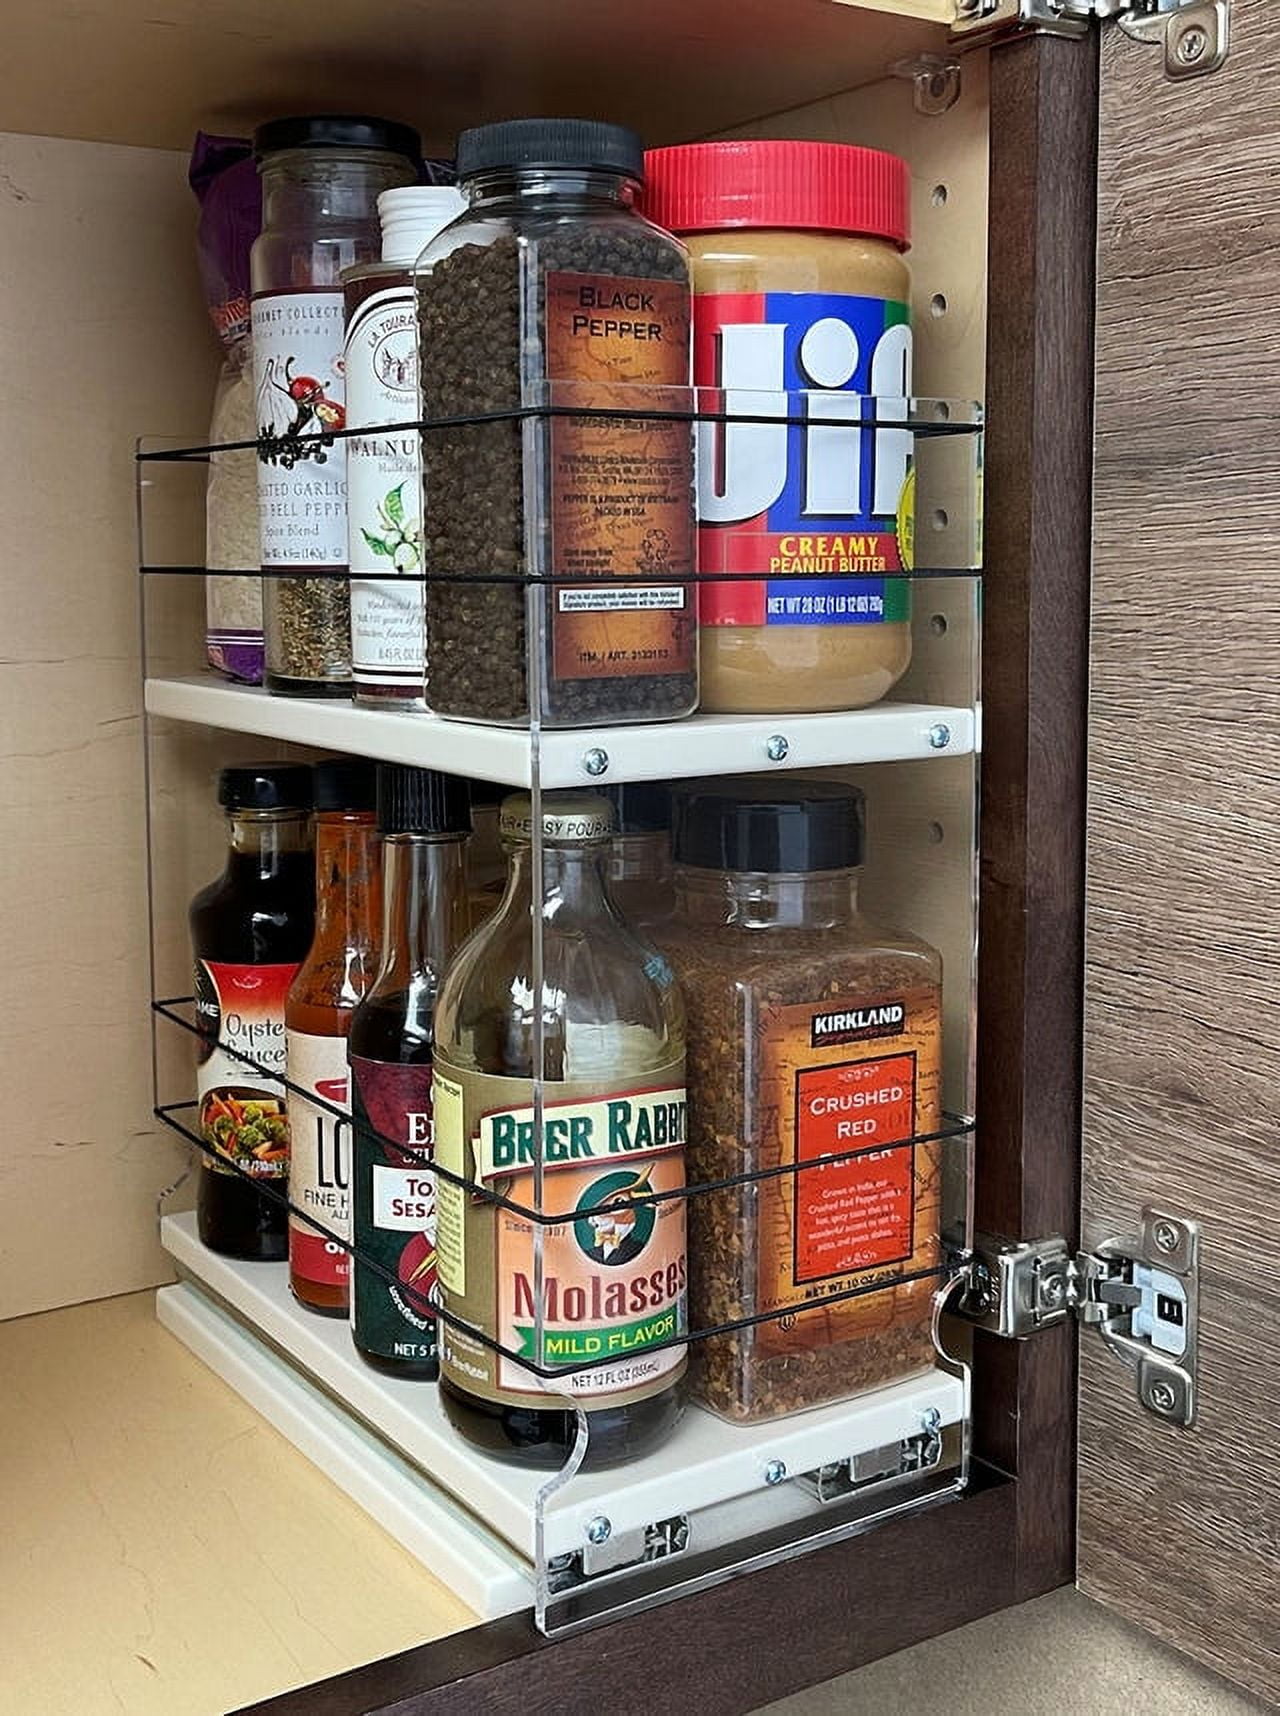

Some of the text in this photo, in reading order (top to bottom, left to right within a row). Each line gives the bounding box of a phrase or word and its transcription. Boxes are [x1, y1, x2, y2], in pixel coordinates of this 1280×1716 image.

[578, 286, 655, 312] BLACK
[572, 315, 663, 342] PEPPER
[696, 317, 914, 523] Jif
[293, 482, 349, 497] GARLIC
[779, 536, 879, 557] CREAMY
[770, 556, 886, 574] PEANUT BUTTER
[767, 597, 784, 614] NET
[814, 1006, 903, 1034] KIRKLAND
[810, 1087, 904, 1116] CRUSHED
[837, 1119, 877, 1140] RED
[491, 1115, 595, 1168] BRER
[304, 1189, 336, 1208] FINE
[406, 1179, 436, 1197] TO
[513, 1254, 688, 1322] Molasses
[546, 1315, 675, 1354] MILD FLAVOR
[395, 1342, 418, 1357] NET
[571, 1375, 592, 1388] NET
